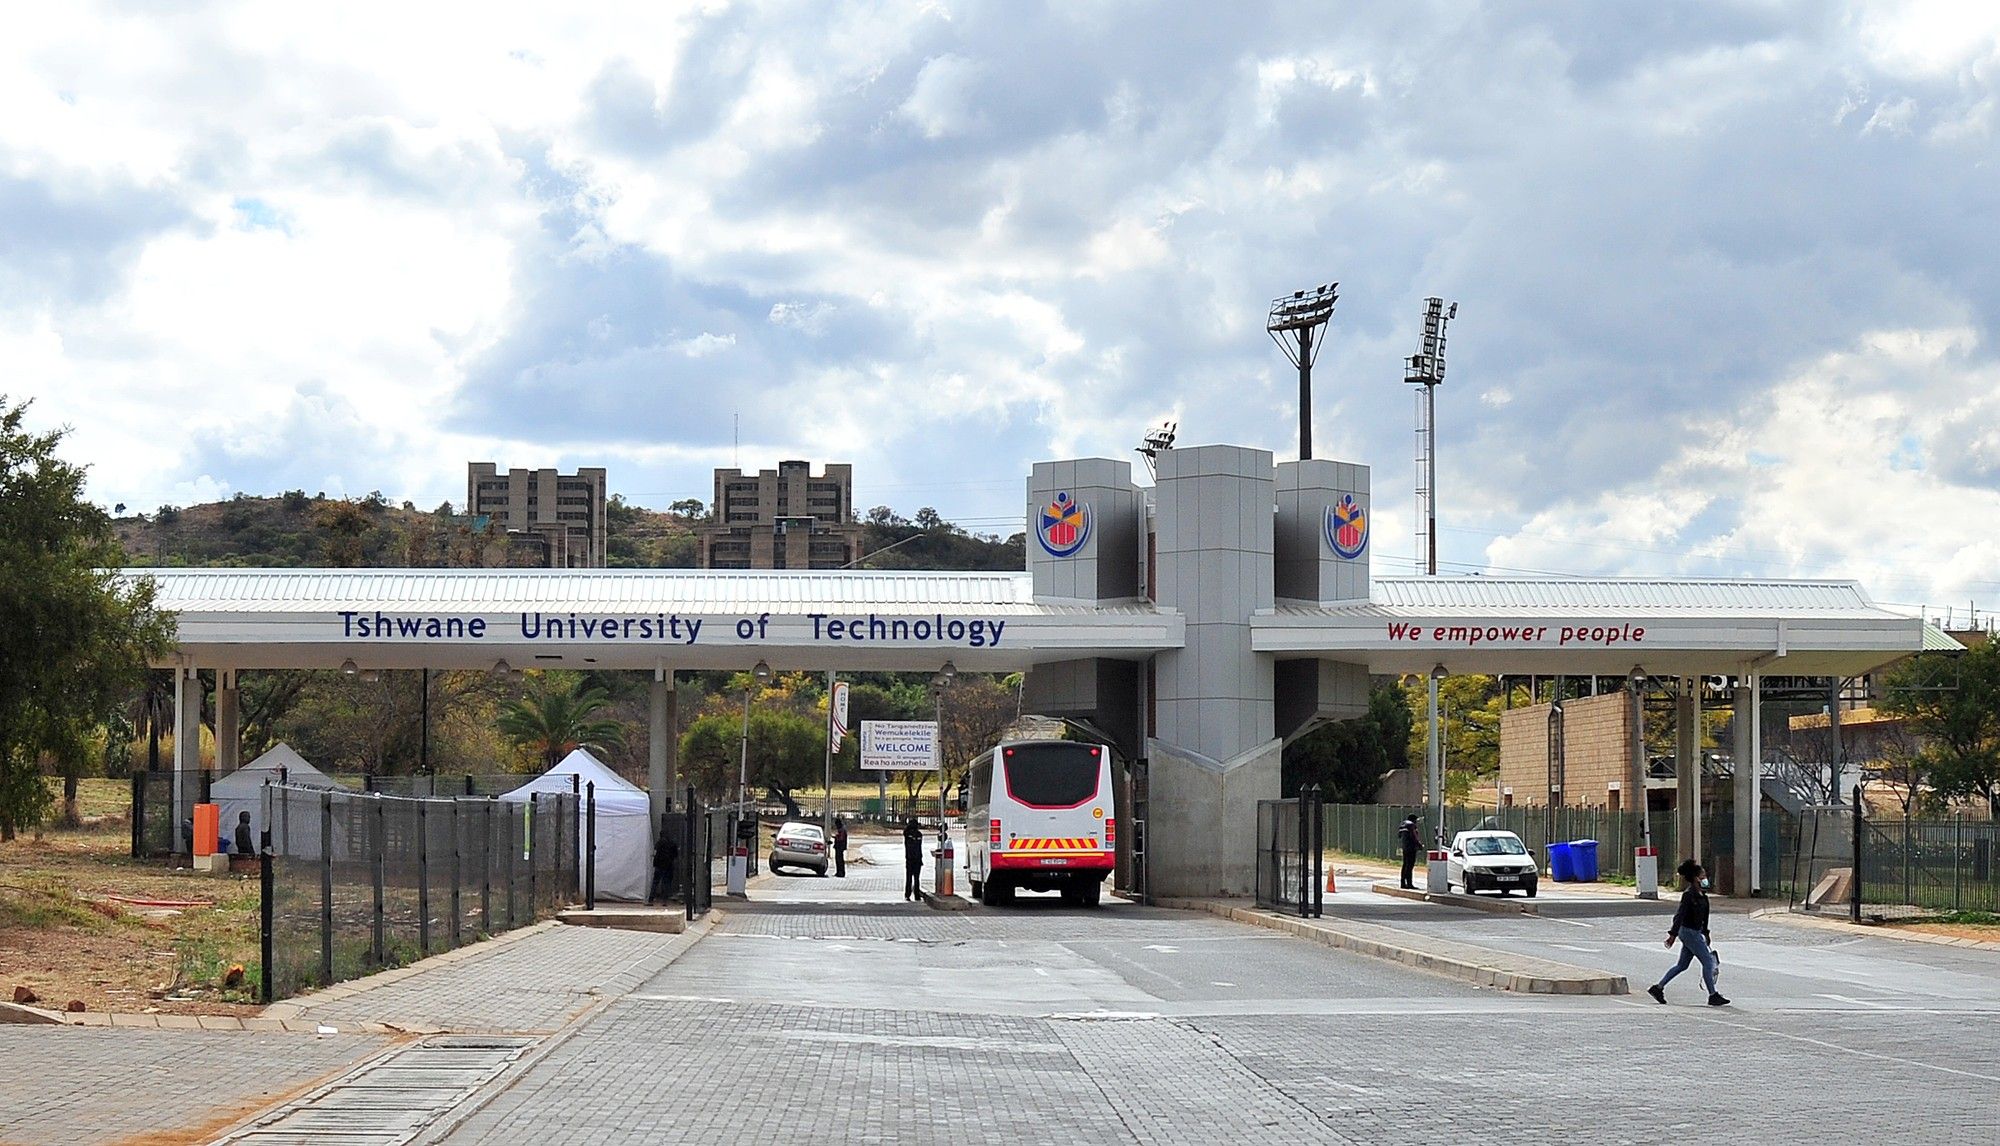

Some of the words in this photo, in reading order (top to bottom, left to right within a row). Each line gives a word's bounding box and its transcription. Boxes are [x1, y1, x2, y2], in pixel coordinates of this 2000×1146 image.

[338, 612, 487, 639] Tshwane
[521, 612, 702, 645] University
[735, 613, 770, 640] of
[806, 614, 1006, 647] Technology
[1387, 622, 1422, 642] We
[1432, 625, 1548, 647] empower
[1559, 622, 1646, 647] people
[875, 744, 931, 752] WELCOME
